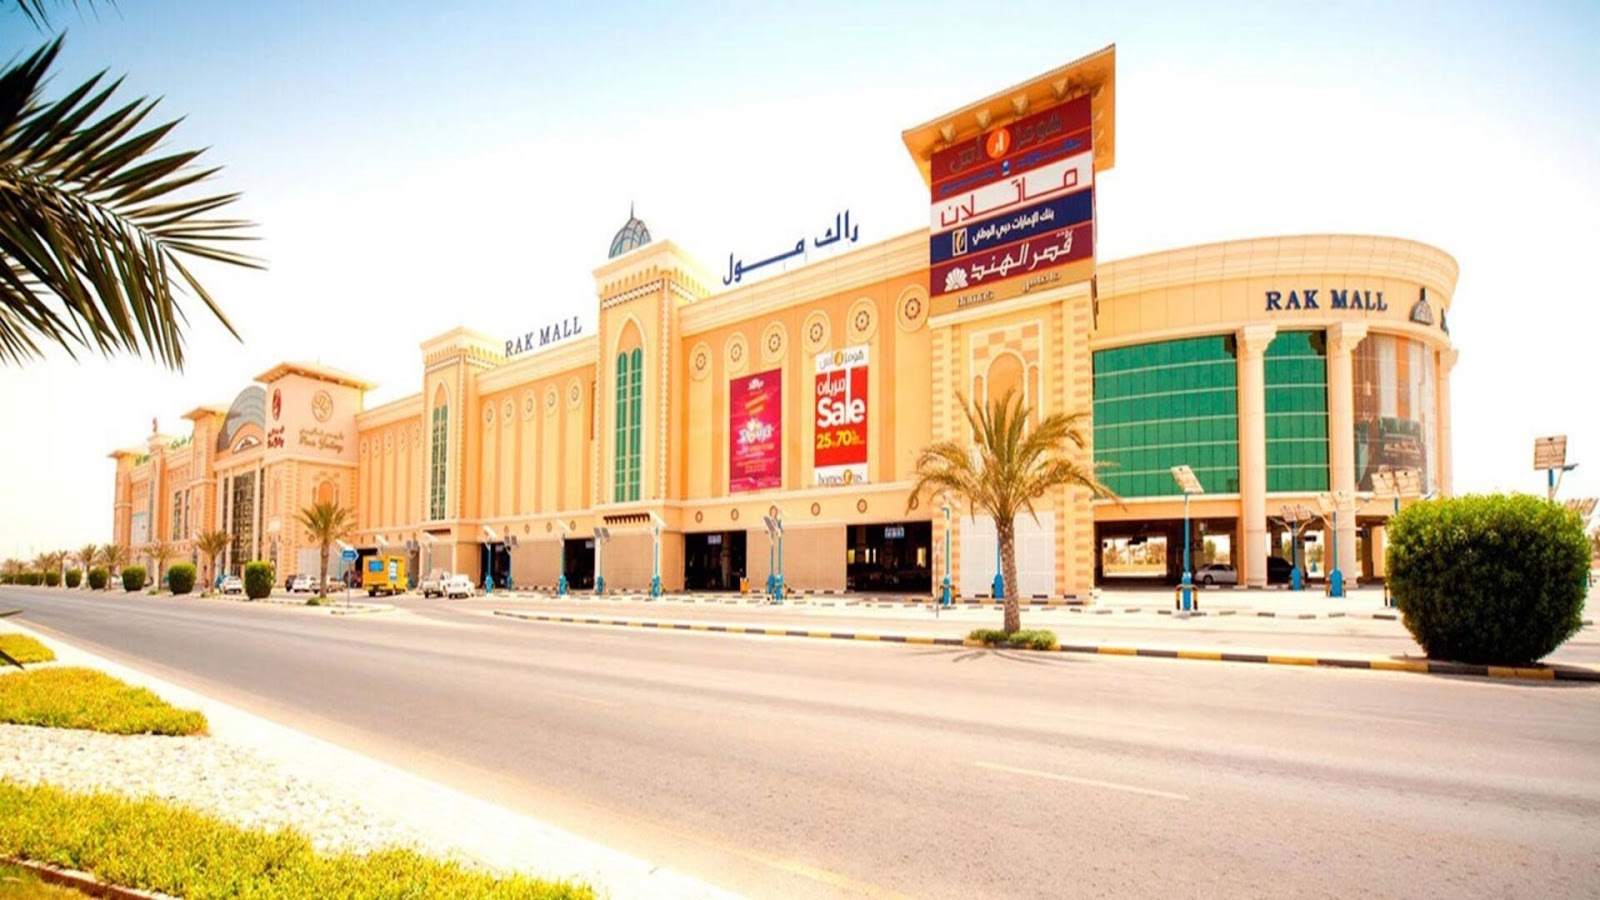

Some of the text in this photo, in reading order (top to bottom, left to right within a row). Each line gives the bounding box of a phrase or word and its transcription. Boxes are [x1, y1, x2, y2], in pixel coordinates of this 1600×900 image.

[722, 209, 859, 286] راك مول
[1265, 289, 1388, 311] RAK MALL
[505, 316, 582, 358] RAK MALL
[817, 385, 865, 428] Sale
